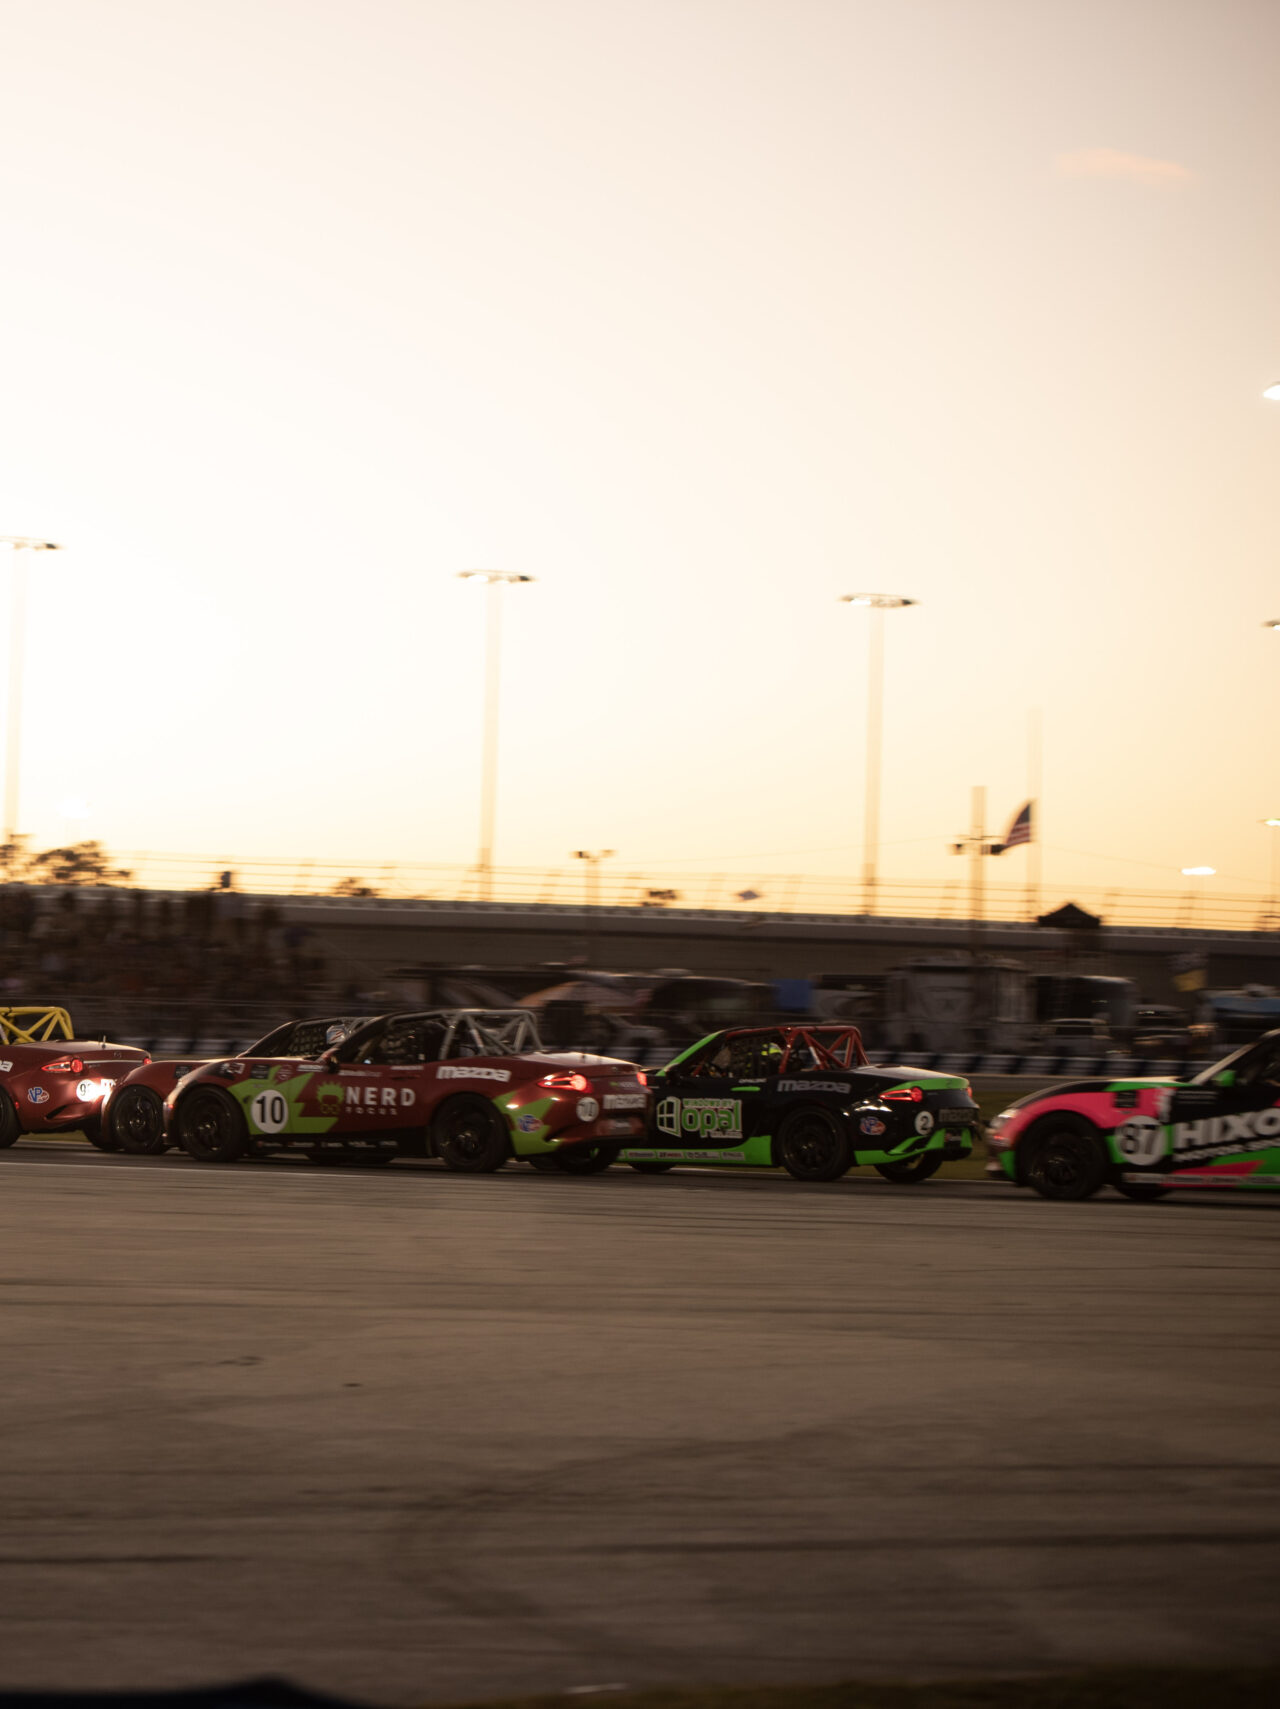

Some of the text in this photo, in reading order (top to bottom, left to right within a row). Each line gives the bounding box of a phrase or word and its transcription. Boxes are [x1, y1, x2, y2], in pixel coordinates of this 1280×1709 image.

[436, 1066, 512, 1083] mazda
[776, 1079, 852, 1094] mazda
[345, 1086, 416, 1106] NERD
[256, 1096, 285, 1123] 10
[345, 1106, 398, 1115] FOCUS
[682, 1100, 741, 1136] opal
[920, 1115, 931, 1131] 2
[1122, 1123, 1156, 1154] 87
